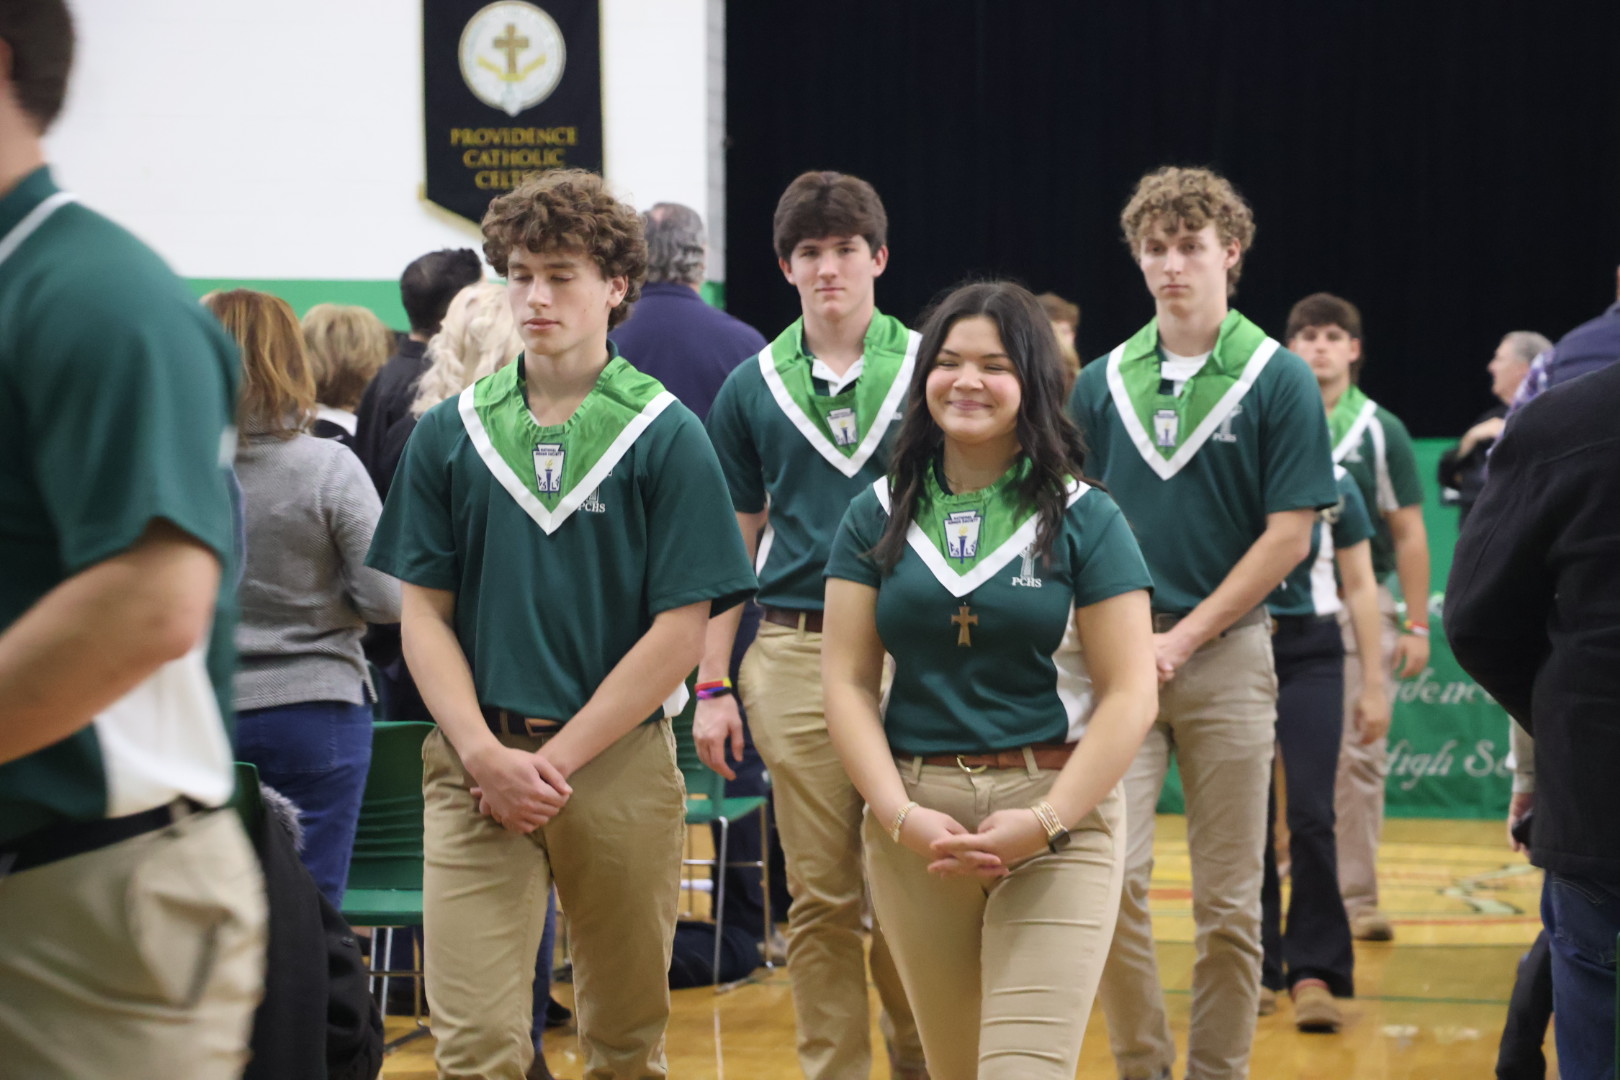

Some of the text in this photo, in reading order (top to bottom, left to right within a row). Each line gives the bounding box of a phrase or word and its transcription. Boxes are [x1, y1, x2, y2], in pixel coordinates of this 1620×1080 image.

[450, 126, 577, 146] PROVIDENCE
[463, 148, 565, 168] CATHOLIC
[1011, 576, 1042, 588] PCHS
